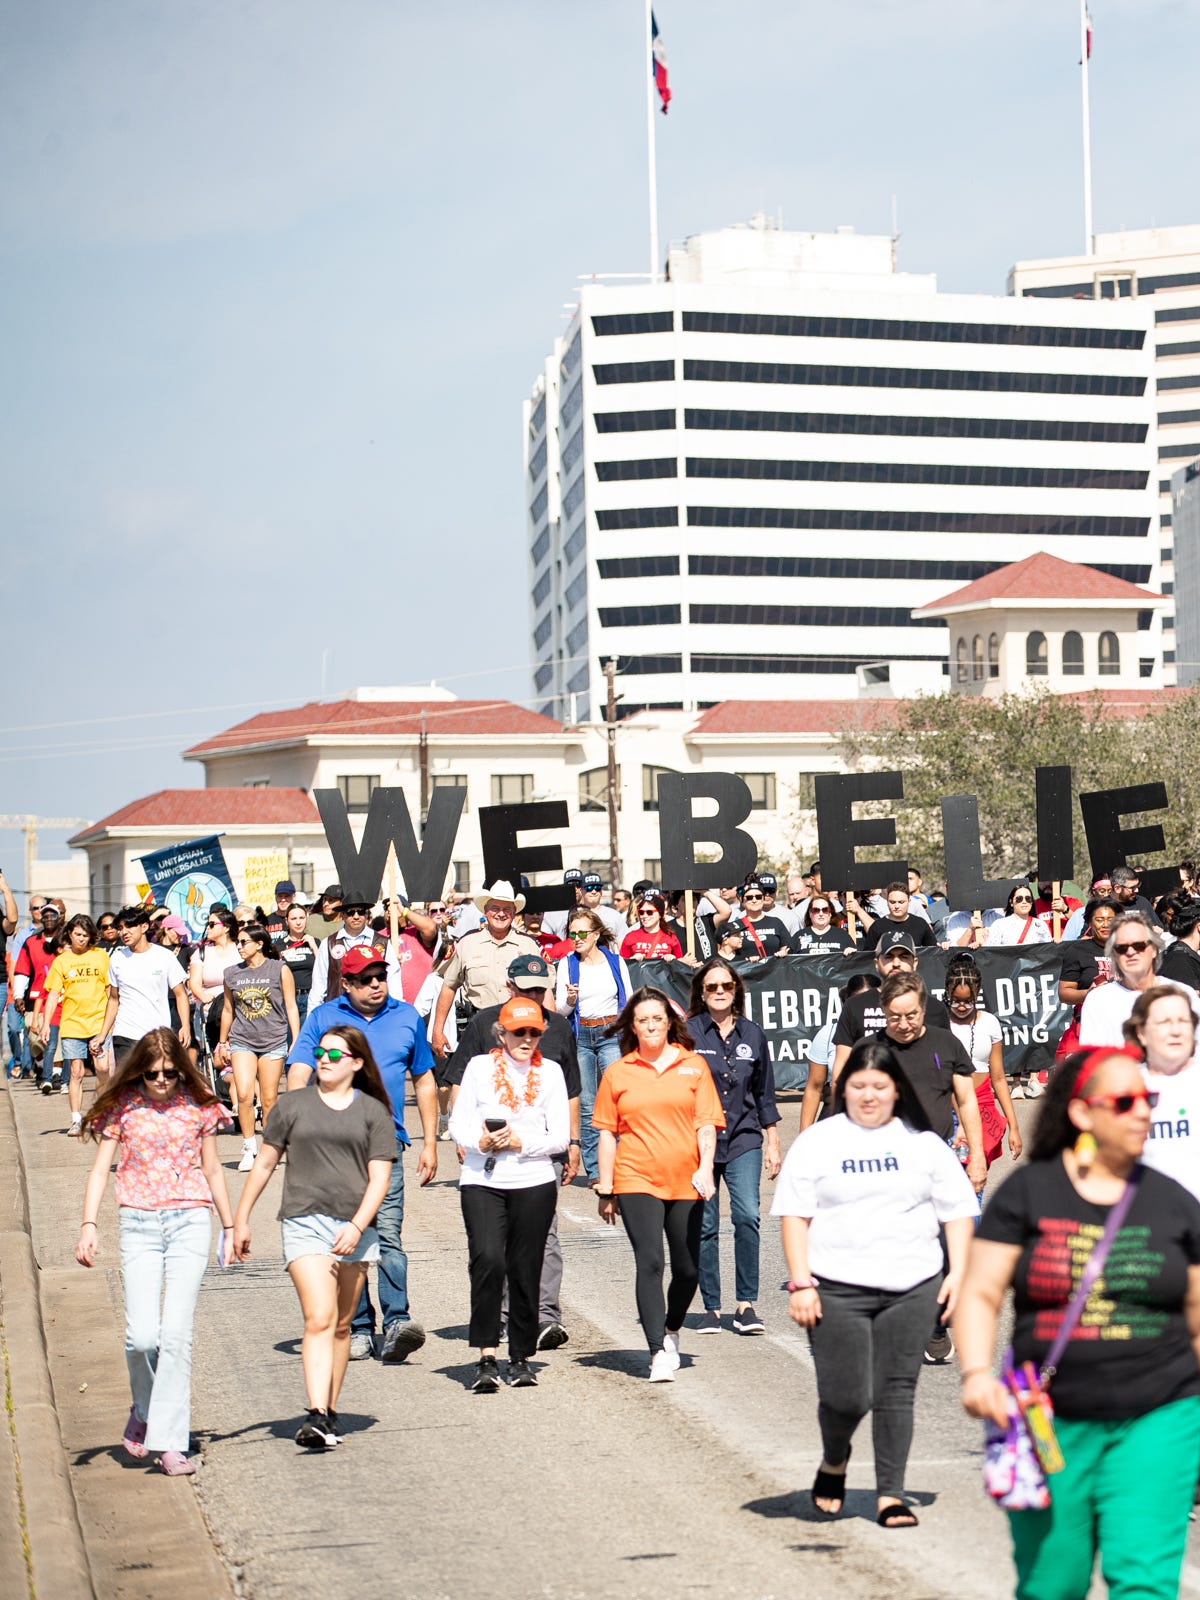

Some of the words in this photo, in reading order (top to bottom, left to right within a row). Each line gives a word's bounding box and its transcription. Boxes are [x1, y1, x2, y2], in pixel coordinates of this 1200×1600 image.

[158, 848, 204, 869] UNITARIAN
[313, 785, 577, 913] WE
[154, 854, 214, 881] UNIVERSALIST
[995, 974, 1064, 1017] DRE
[1001, 1024, 1049, 1046] ING
[1150, 1119, 1190, 1139] MA
